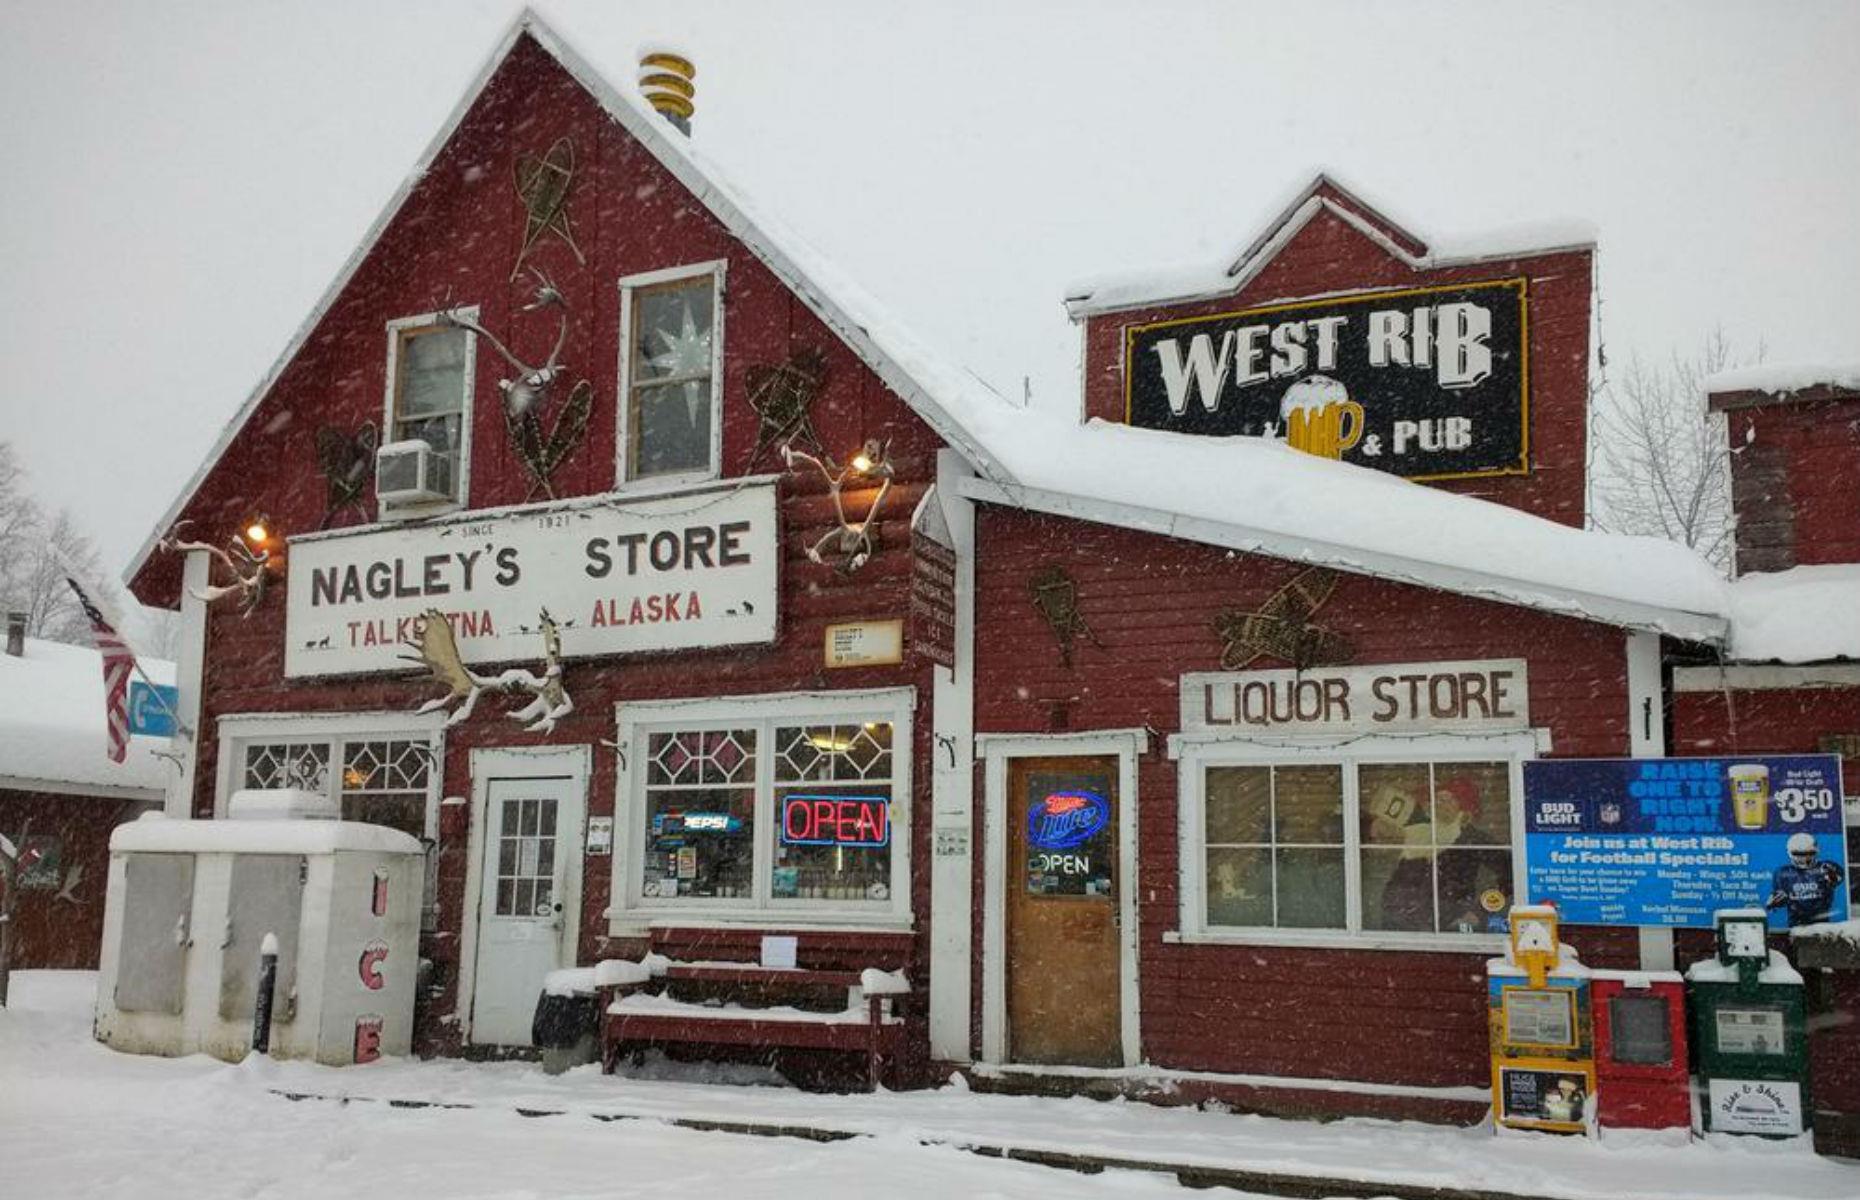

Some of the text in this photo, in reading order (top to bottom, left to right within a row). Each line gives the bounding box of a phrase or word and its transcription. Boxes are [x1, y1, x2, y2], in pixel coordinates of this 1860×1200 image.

[1151, 301, 1494, 416] WEST RIB
[1362, 415, 1473, 456] & PUB
[460, 523, 494, 538] SINCE
[311, 520, 752, 607] NAGLEY'S STORE
[347, 591, 702, 649] TALKETNA, ALASKA
[1204, 670, 1516, 726] LIQUOR STORE
[1630, 780, 1681, 798] ONE
[1688, 780, 1723, 797] TO
[1541, 803, 1575, 814] BUD
[787, 801, 885, 842] OPEN
[1536, 813, 1583, 825] LIGHT
[1563, 836, 1735, 850] Join us at West Rib
[1038, 853, 1090, 875] OPEN
[1550, 851, 1749, 867] for Football Specials!
[1657, 869, 1691, 879] Monday
[1700, 869, 1727, 880] Wings
[1671, 890, 1703, 900] Sunday
[353, 865, 390, 1065] ICE
